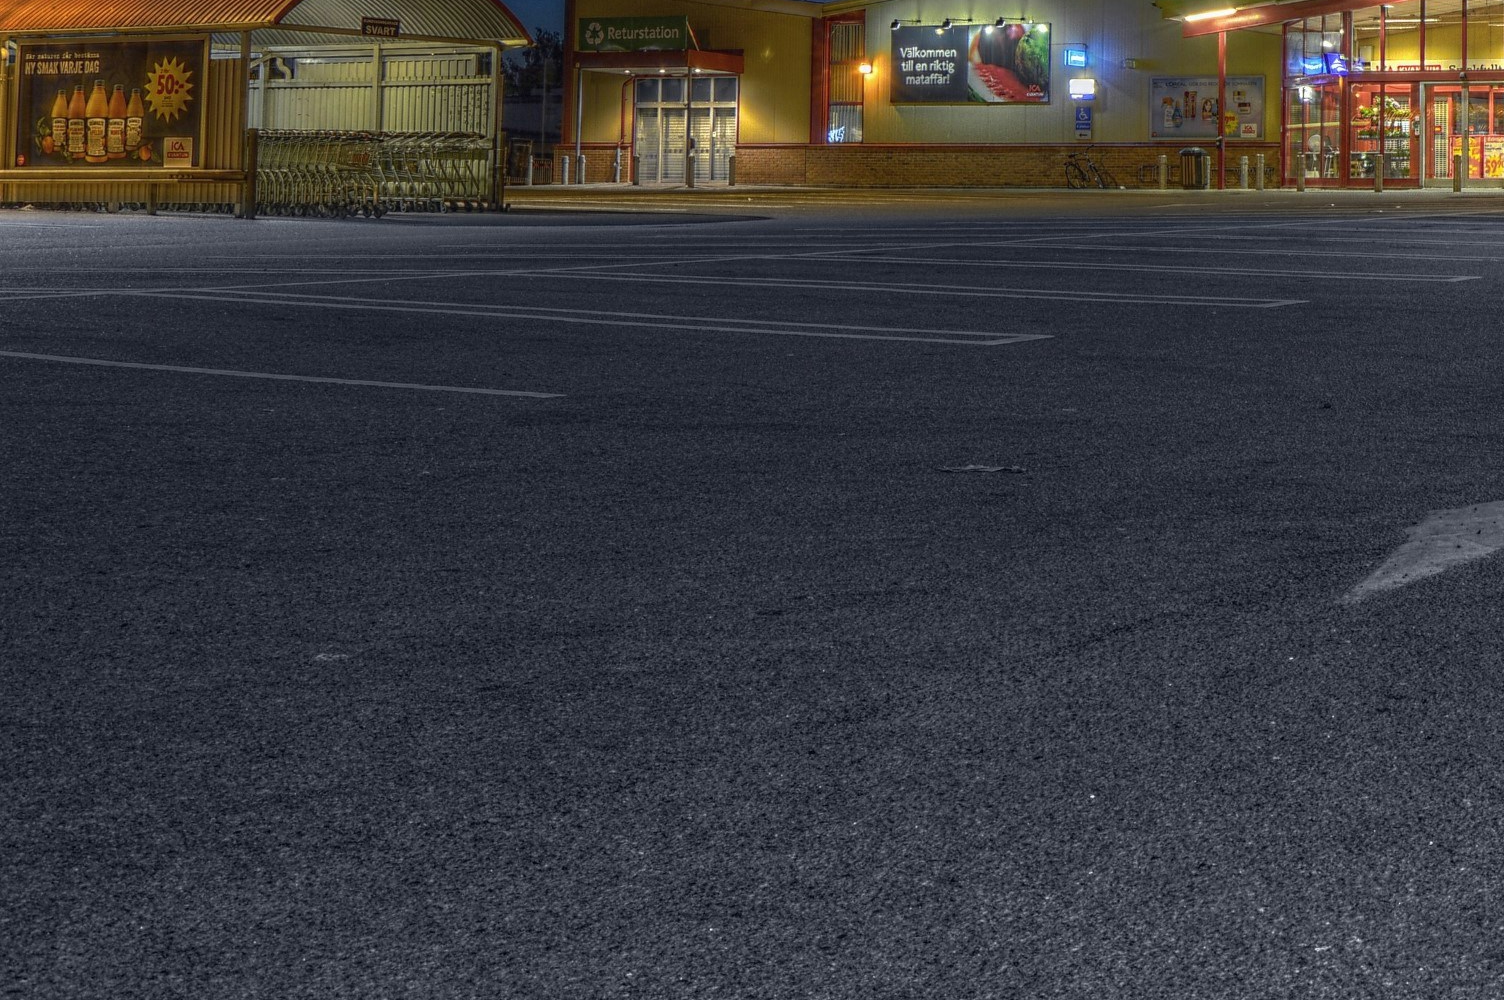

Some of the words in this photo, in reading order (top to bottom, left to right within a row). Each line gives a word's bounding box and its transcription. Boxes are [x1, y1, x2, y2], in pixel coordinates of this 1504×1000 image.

[366, 25, 396, 36] SVART
[607, 26, 679, 40] Returstation
[900, 47, 957, 58] Välkommen
[25, 61, 35, 75] NY
[37, 61, 59, 75] SMAK
[59, 61, 84, 75] VARJE
[85, 60, 100, 74] DAG
[901, 60, 914, 72] till
[915, 63, 928, 72] en
[929, 60, 955, 74] riktig
[156, 74, 185, 95] 50:-
[906, 70, 950, 85] mataffär!
[1028, 84, 1041, 92] ICA
[171, 141, 185, 151] ICA
